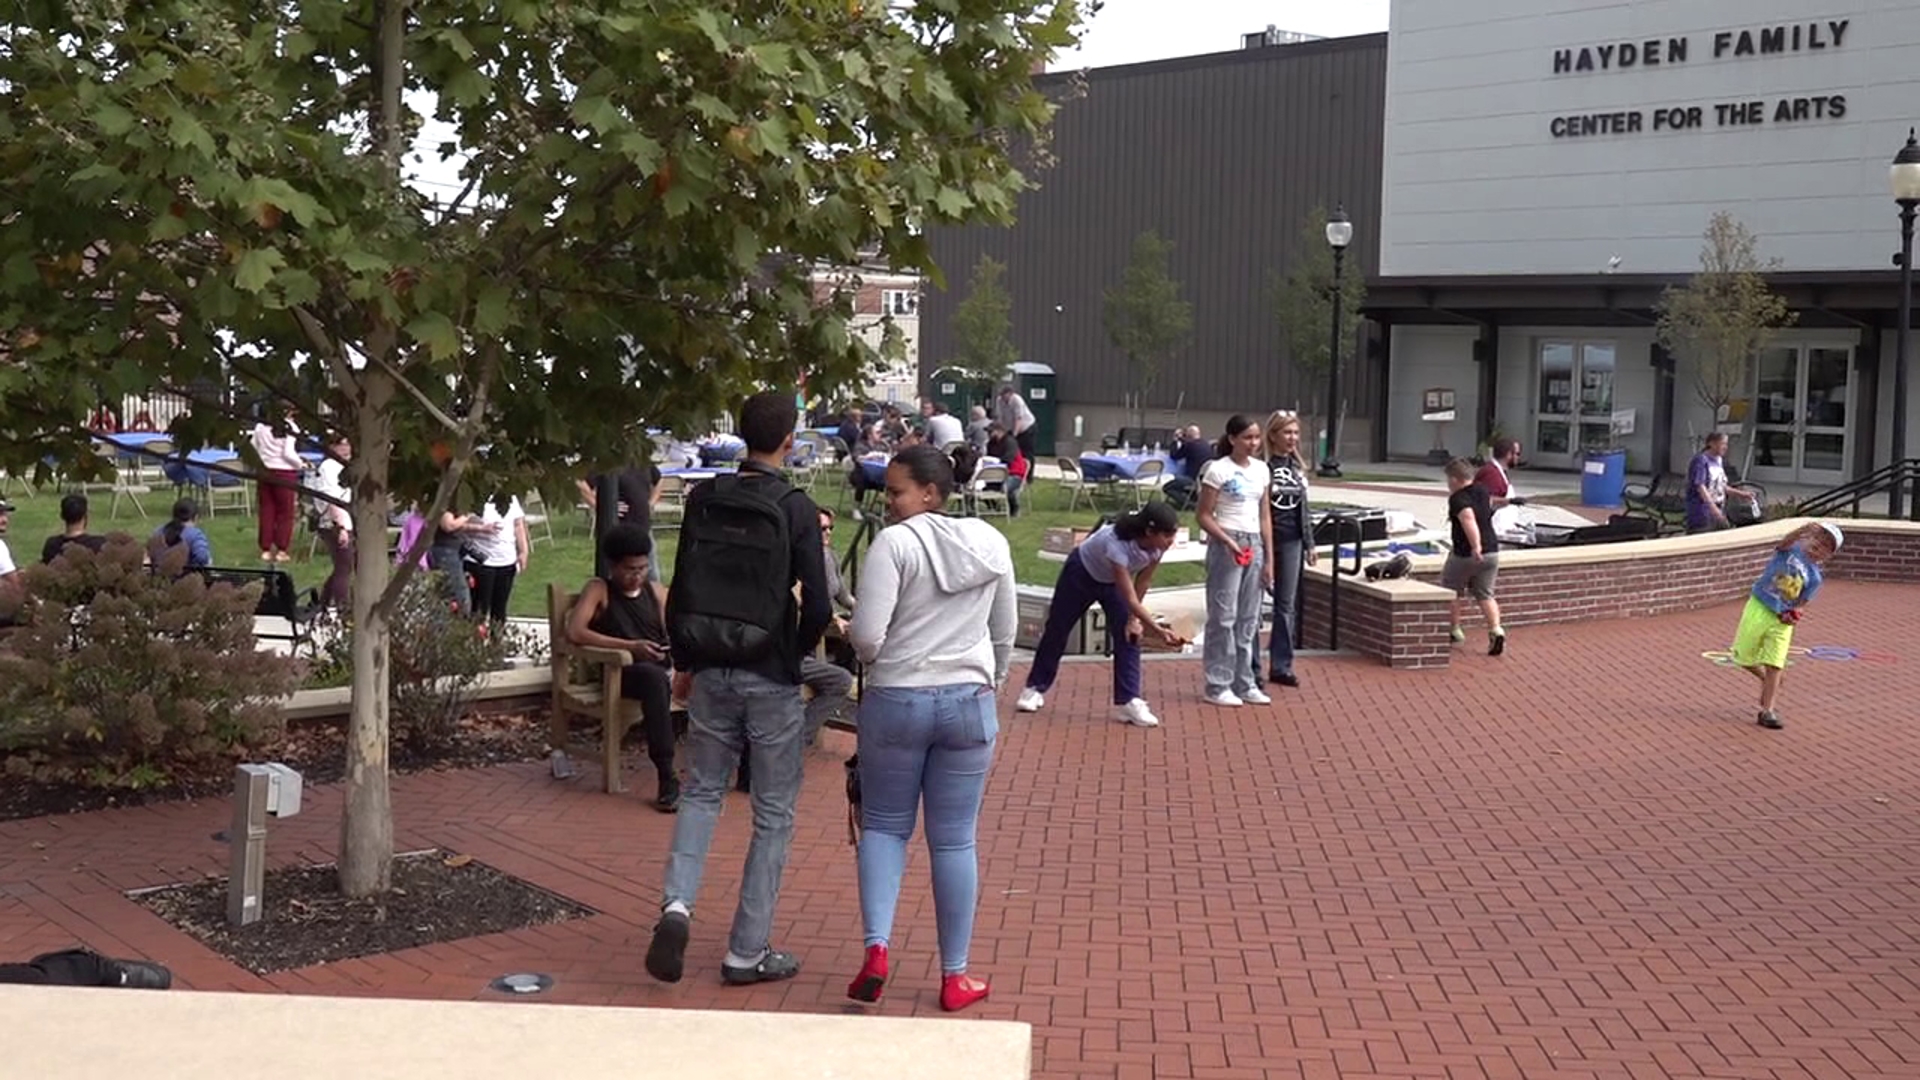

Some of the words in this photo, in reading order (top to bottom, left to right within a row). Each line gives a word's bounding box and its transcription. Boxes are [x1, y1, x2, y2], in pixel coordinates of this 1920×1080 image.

[1553, 37, 1688, 74] HAYDEN
[1713, 20, 1849, 57] FAMILY
[1550, 111, 1642, 138] CENTER
[1653, 106, 1703, 131] FOR
[1714, 101, 1764, 126] THE
[1773, 95, 1846, 122] ARTS
